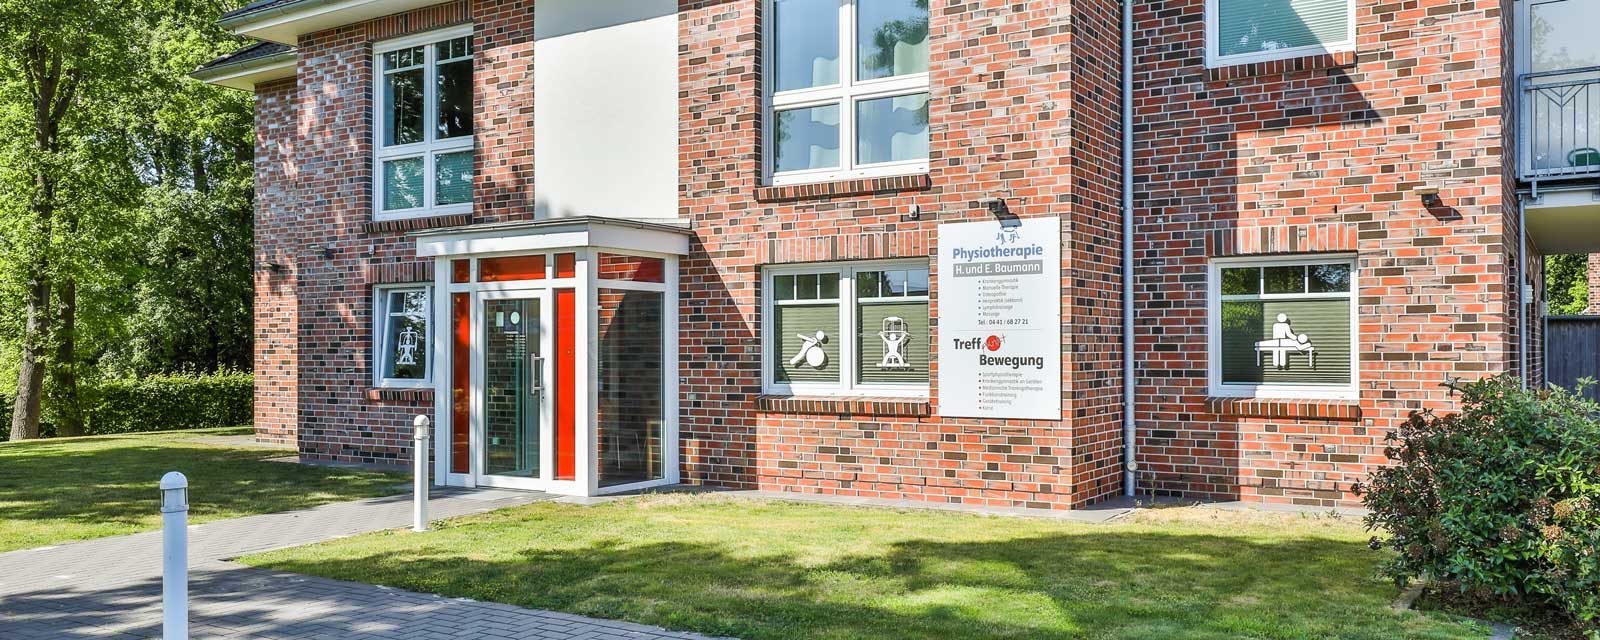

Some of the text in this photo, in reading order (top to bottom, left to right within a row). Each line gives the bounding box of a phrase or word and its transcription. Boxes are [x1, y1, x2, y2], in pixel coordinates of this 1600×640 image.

[953, 244, 1043, 262] Physiotherapie
[966, 263, 982, 274] und
[985, 264, 992, 273] E.
[995, 263, 1040, 273] Baumann
[954, 338, 981, 350] Treff
[980, 355, 1043, 369] Bewegung
